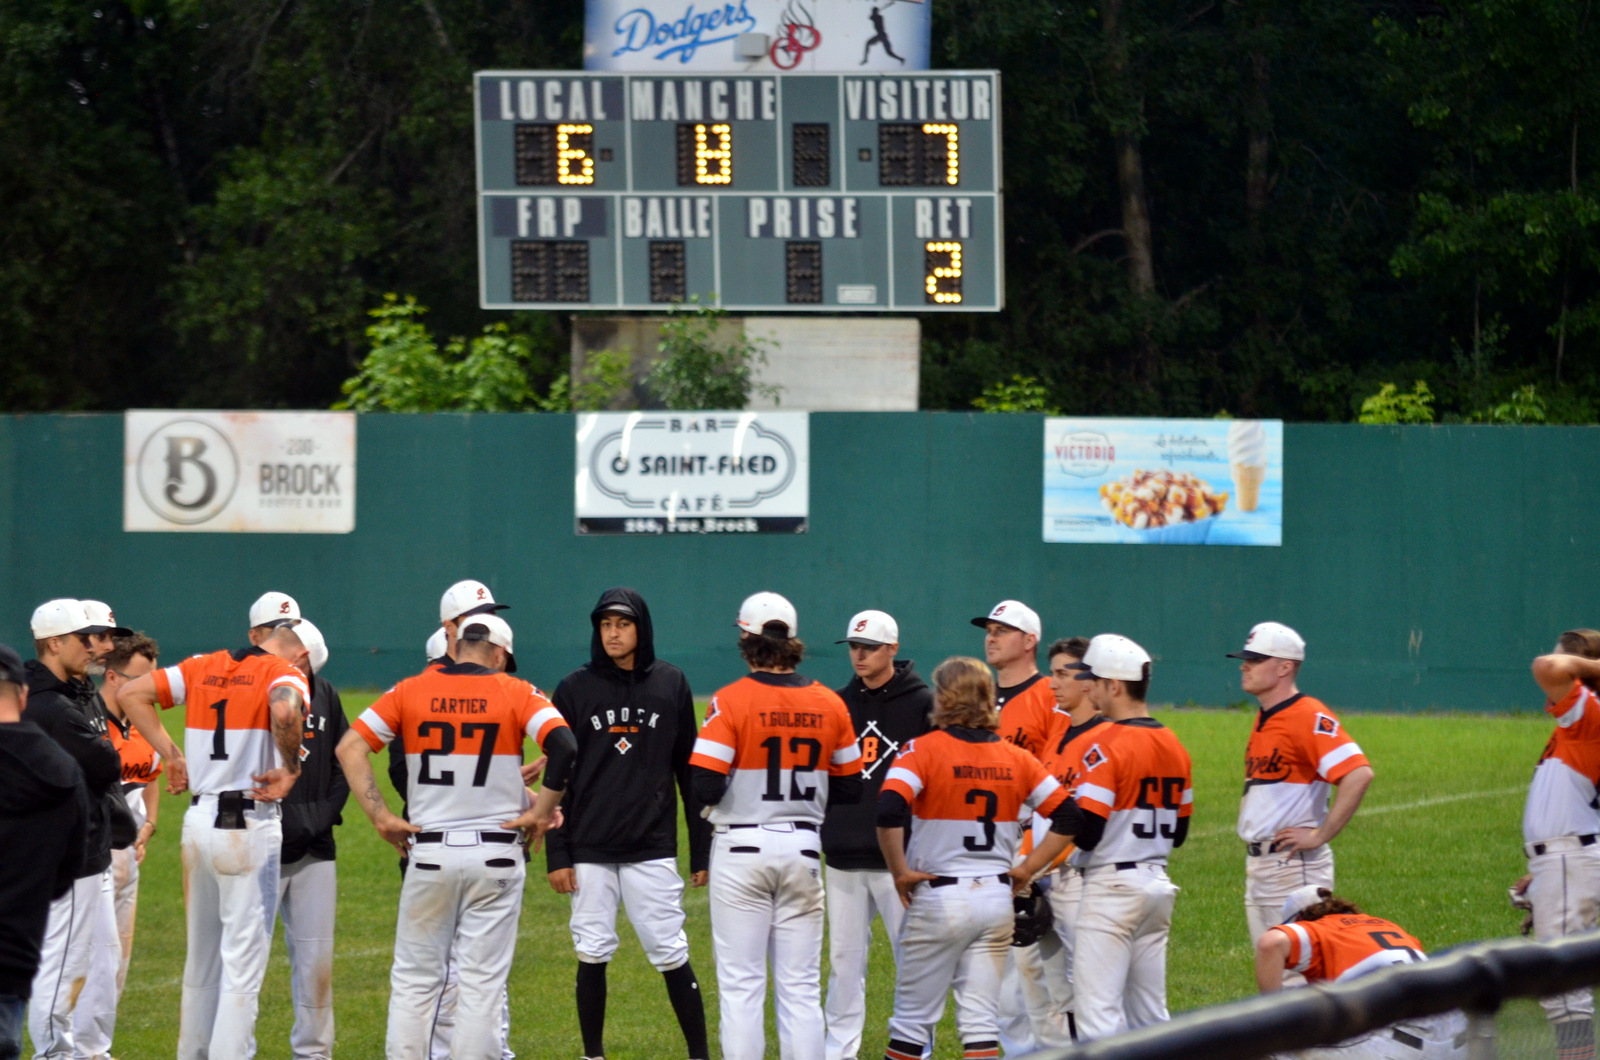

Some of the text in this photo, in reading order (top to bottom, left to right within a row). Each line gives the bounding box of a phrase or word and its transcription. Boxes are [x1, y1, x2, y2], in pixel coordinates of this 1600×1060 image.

[612, 2, 756, 63] Dodgers
[500, 80, 606, 120] LOCAL
[632, 80, 775, 120] MANCHE
[845, 80, 991, 120] VISITEUR
[557, 124, 594, 184] 6
[695, 124, 732, 184] 8
[922, 123, 958, 185] 7
[517, 197, 582, 238] FRP
[624, 197, 711, 238] BALLE
[749, 198, 858, 238] PRISE
[915, 198, 972, 238] RET
[926, 242, 962, 303] 2
[669, 419, 719, 433] BAR
[164, 436, 218, 512] B
[259, 463, 342, 496] BROCK
[660, 495, 724, 511] CAFÉ
[703, 518, 758, 533] Brock
[430, 698, 488, 715] CARTIER
[209, 699, 229, 761] 1
[862, 737, 879, 763] B
[417, 721, 501, 787] 27
[760, 736, 822, 802] 12
[963, 789, 998, 851] 3
[1132, 777, 1185, 840] 55
